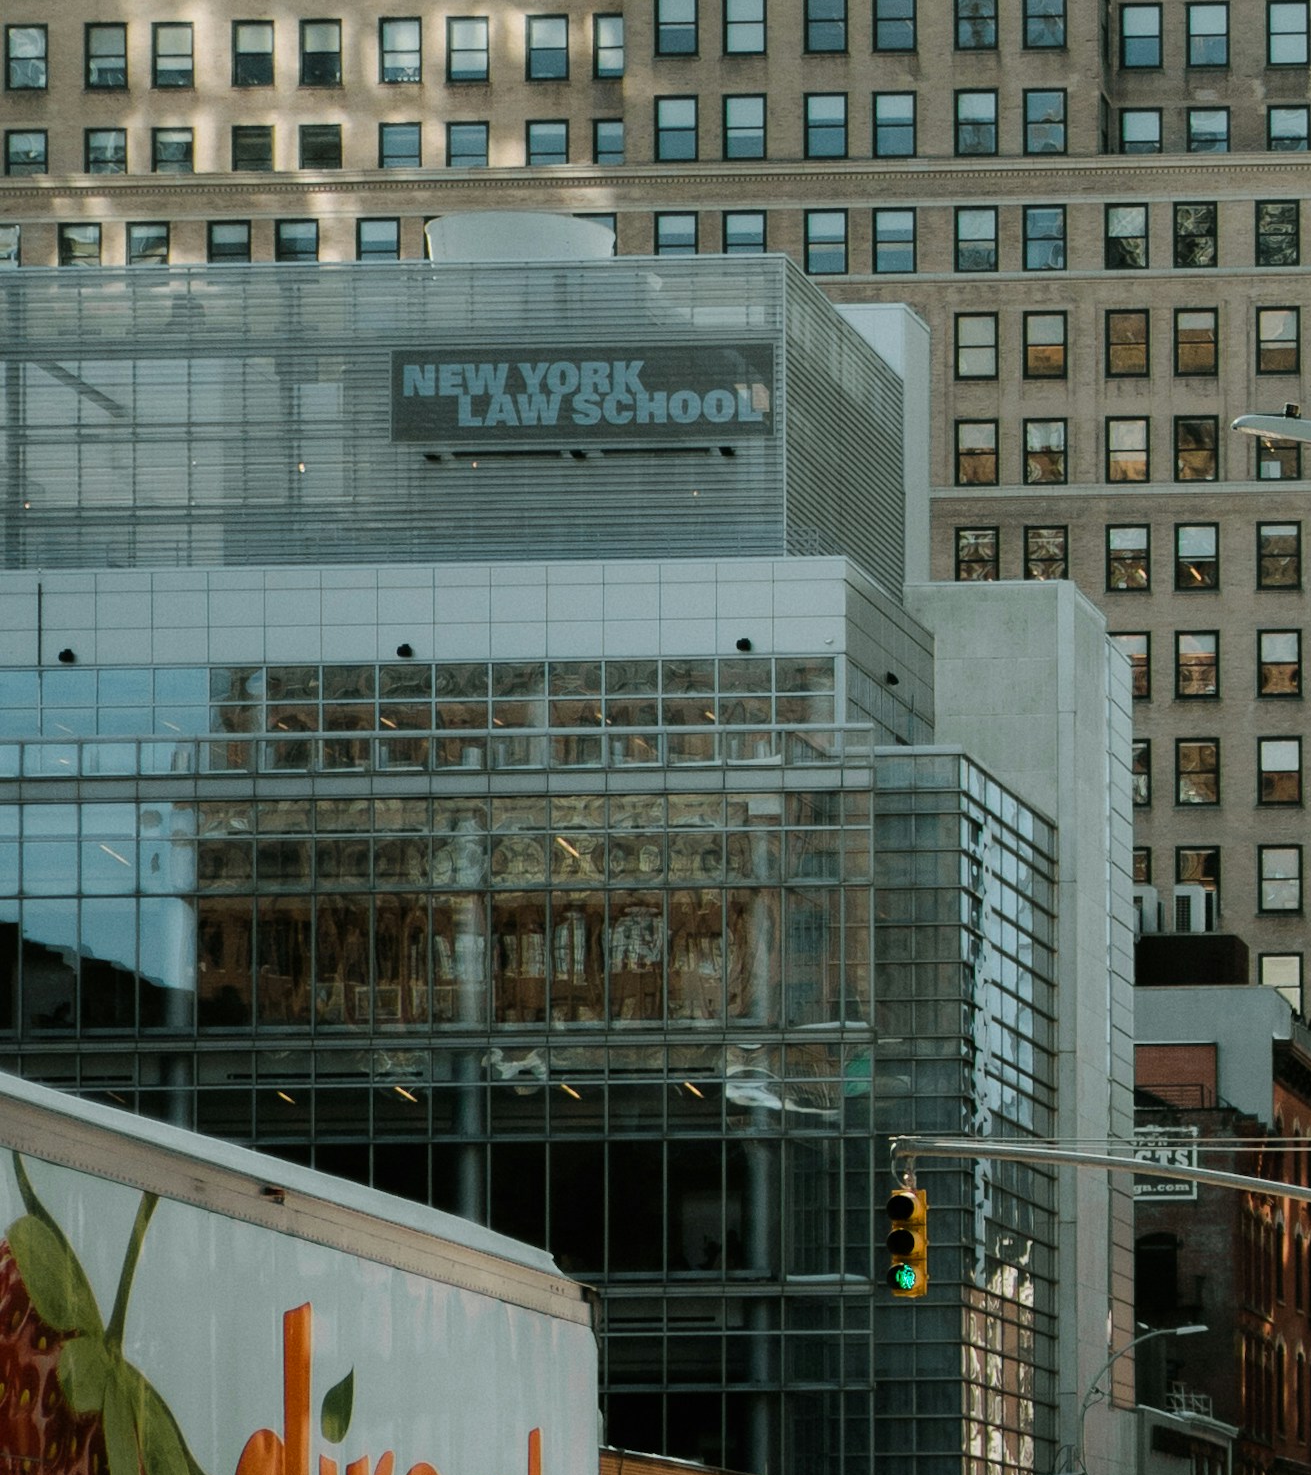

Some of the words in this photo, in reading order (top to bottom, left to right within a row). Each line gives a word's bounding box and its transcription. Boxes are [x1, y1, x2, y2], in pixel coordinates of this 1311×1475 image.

[403, 363, 509, 397] NEW
[517, 360, 646, 395] YORK
[458, 392, 562, 426] LAW
[571, 389, 764, 426] SCHOOL
[1133, 1184, 1190, 1194] gn.com
